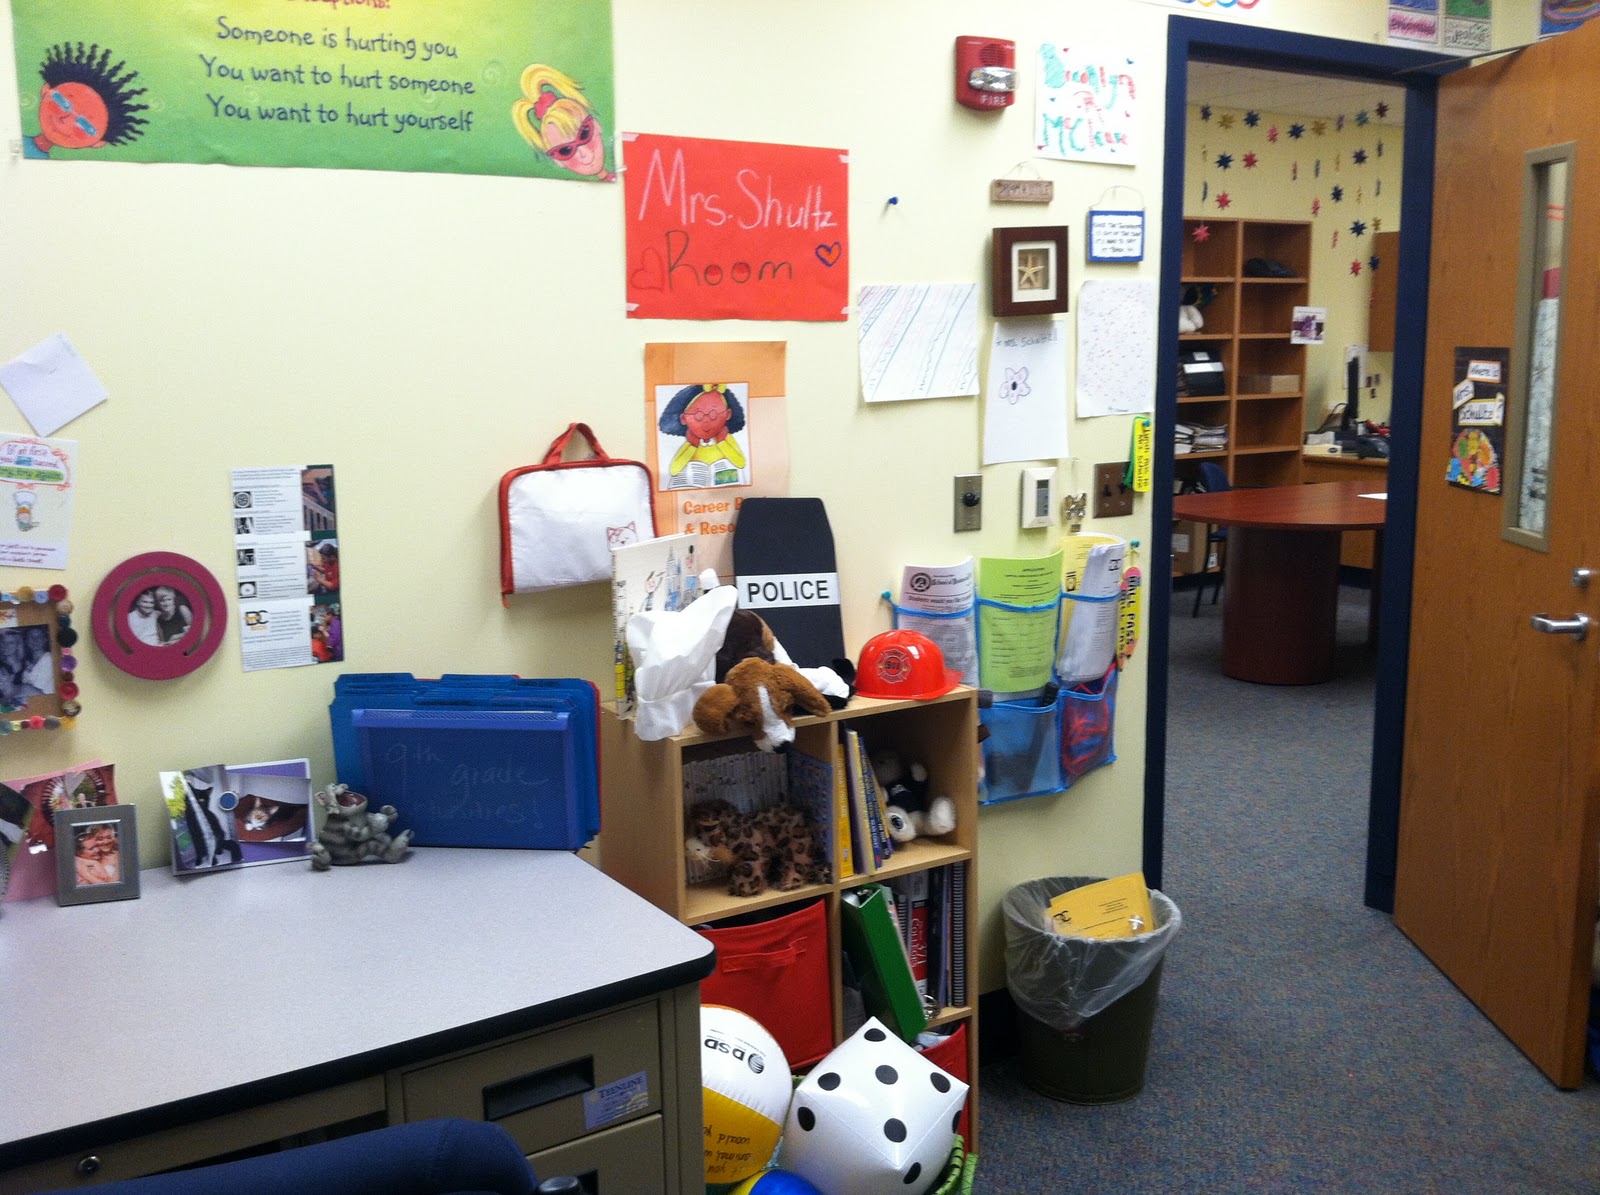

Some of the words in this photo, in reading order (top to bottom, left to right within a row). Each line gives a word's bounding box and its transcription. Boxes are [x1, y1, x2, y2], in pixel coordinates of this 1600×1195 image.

[216, 16, 315, 47] Someone
[321, 28, 338, 49] is
[345, 26, 417, 60] hurting
[423, 41, 458, 61] you
[200, 54, 245, 82] You
[251, 58, 305, 85] want
[311, 64, 333, 85] to
[340, 65, 384, 90] hurt
[388, 75, 475, 96] someone
[206, 94, 251, 121] You
[258, 98, 312, 123] want
[318, 104, 340, 126] to
[346, 103, 390, 128] hurt
[393, 111, 474, 135] yourself
[980, 95, 1007, 106] FIRE
[736, 168, 838, 232] Shultz
[664, 229, 793, 293] Room
[684, 500, 729, 515] Career
[684, 522, 695, 534] &
[700, 521, 737, 535] Reso
[747, 580, 830, 603] POLICE
[1126, 575, 1138, 608] HALL
[1126, 613, 1136, 646] PASS
[916, 944, 927, 965] 371
[598, 1075, 643, 1098] TEENLINE
